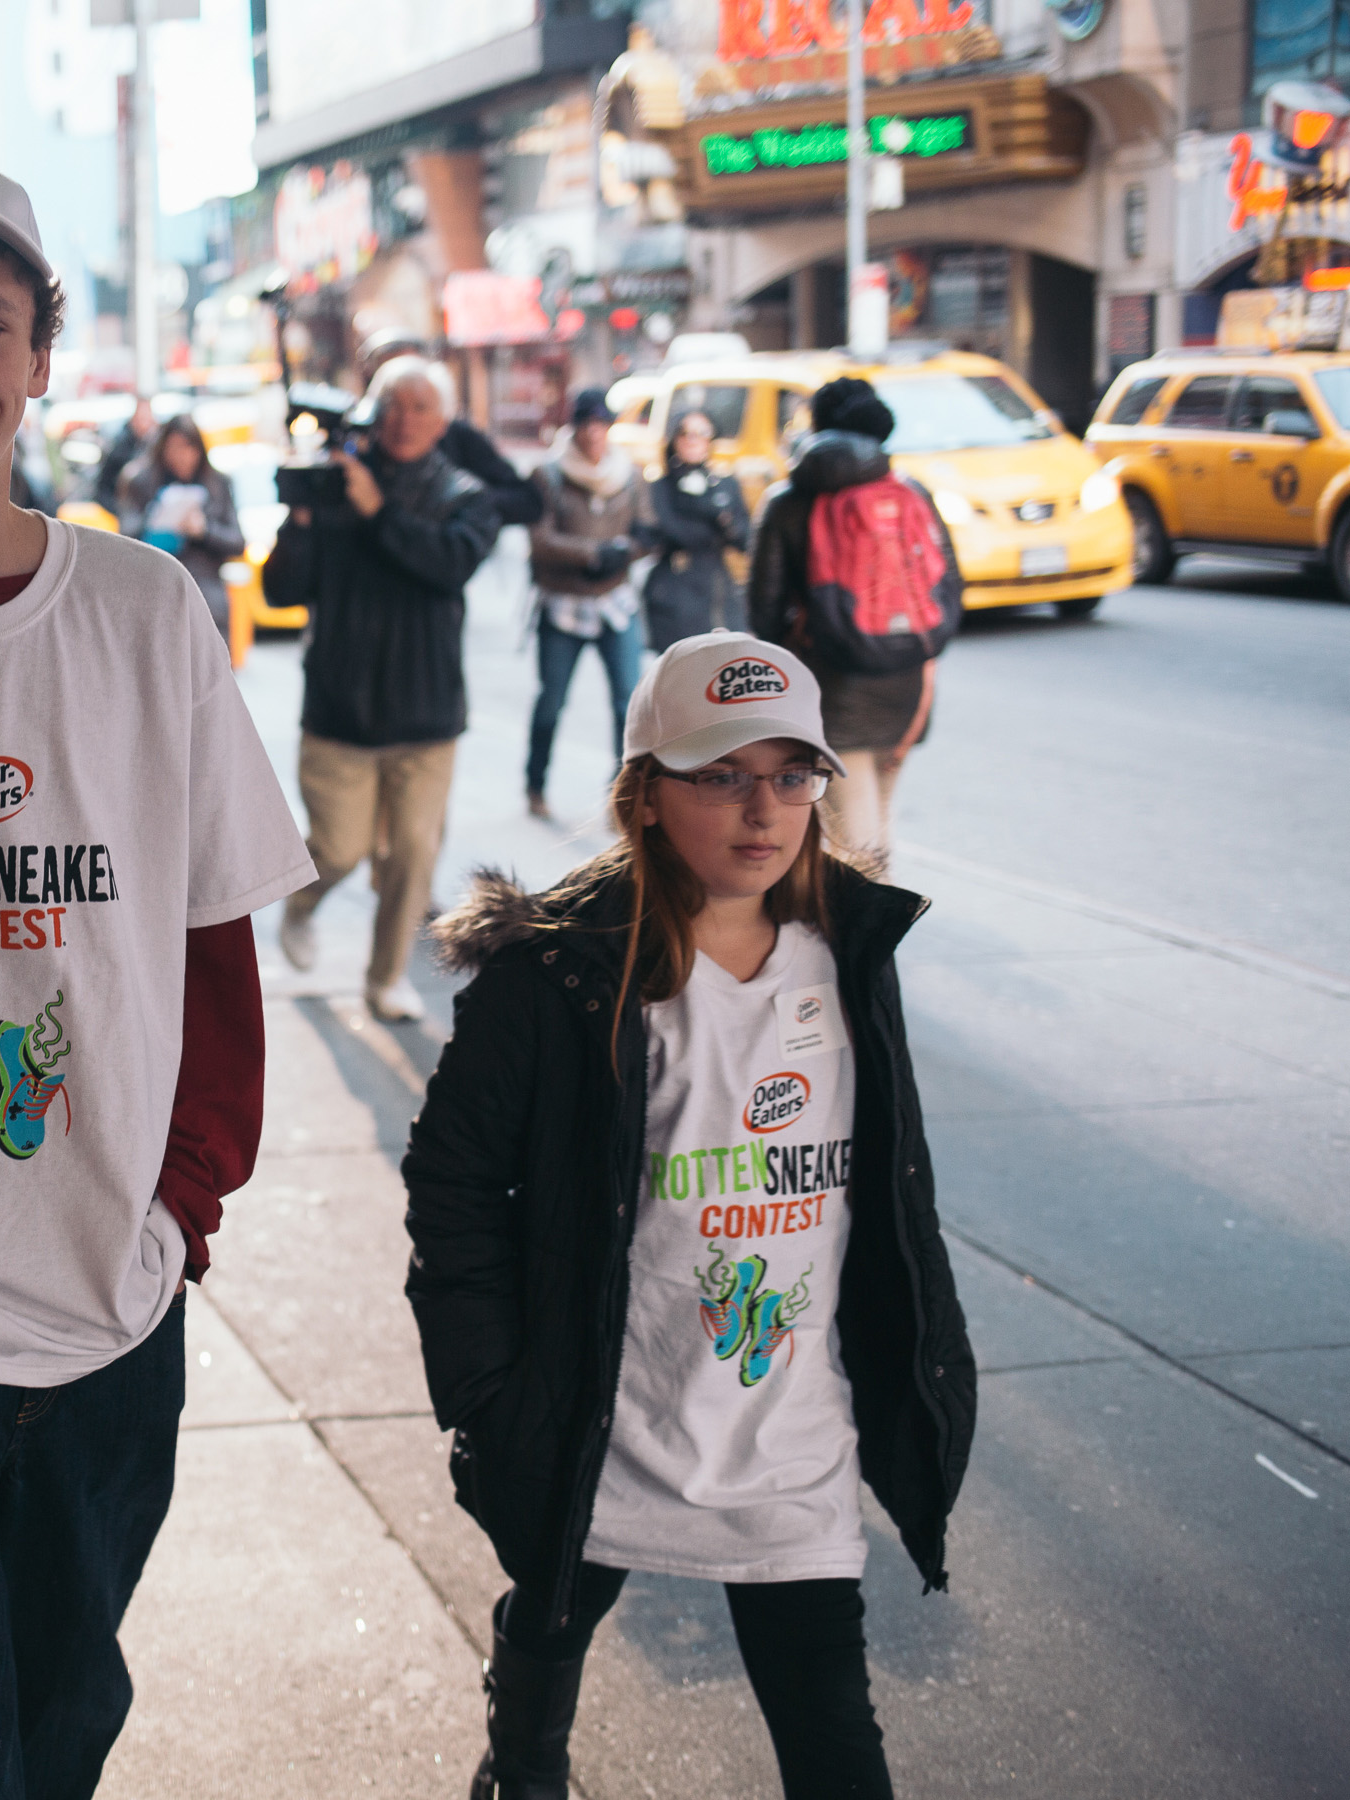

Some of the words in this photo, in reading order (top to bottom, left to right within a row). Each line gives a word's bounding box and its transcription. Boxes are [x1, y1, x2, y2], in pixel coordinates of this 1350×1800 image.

[719, 661, 775, 684] Odor-
[718, 678, 785, 703] Eaters
[754, 1076, 799, 1107] Odor-
[750, 1095, 804, 1130] Eaters
[650, 1137, 769, 1200] ROTTEN
[764, 1138, 851, 1196] SNEAKE
[700, 1193, 827, 1239] CONTEST
